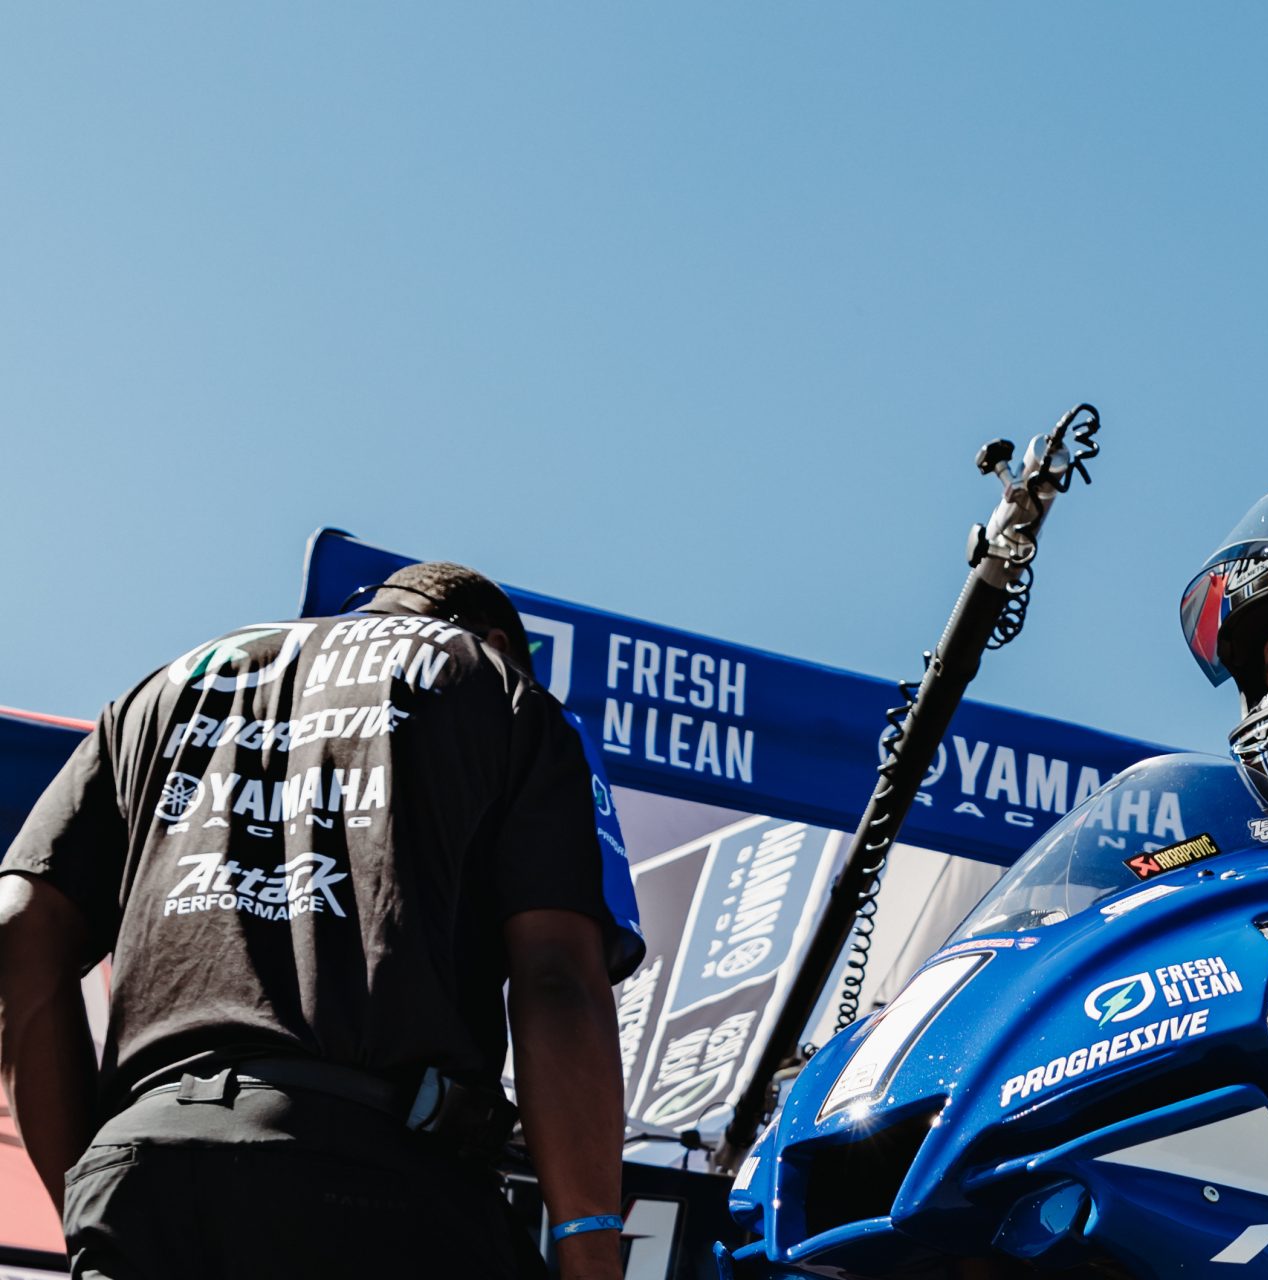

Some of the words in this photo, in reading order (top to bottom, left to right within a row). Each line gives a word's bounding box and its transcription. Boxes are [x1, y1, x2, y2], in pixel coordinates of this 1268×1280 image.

[321, 616, 463, 649] FRESH
[303, 651, 334, 697] N
[335, 639, 449, 690] LEAN
[606, 633, 746, 717] FRESH
[603, 698, 633, 755] N
[645, 707, 754, 783] LEAN
[210, 765, 385, 822] YAMAHA
[952, 735, 1186, 841] YAMAHA
[167, 814, 372, 838] RACING
[164, 894, 325, 920] PERFORMANCE
[167, 852, 348, 918] Attack
[1155, 956, 1228, 986] FRESH
[1162, 983, 1183, 1007] N
[1182, 971, 1243, 1003] LEAN
[1000, 1008, 1209, 1107] PROGRESSIVE
